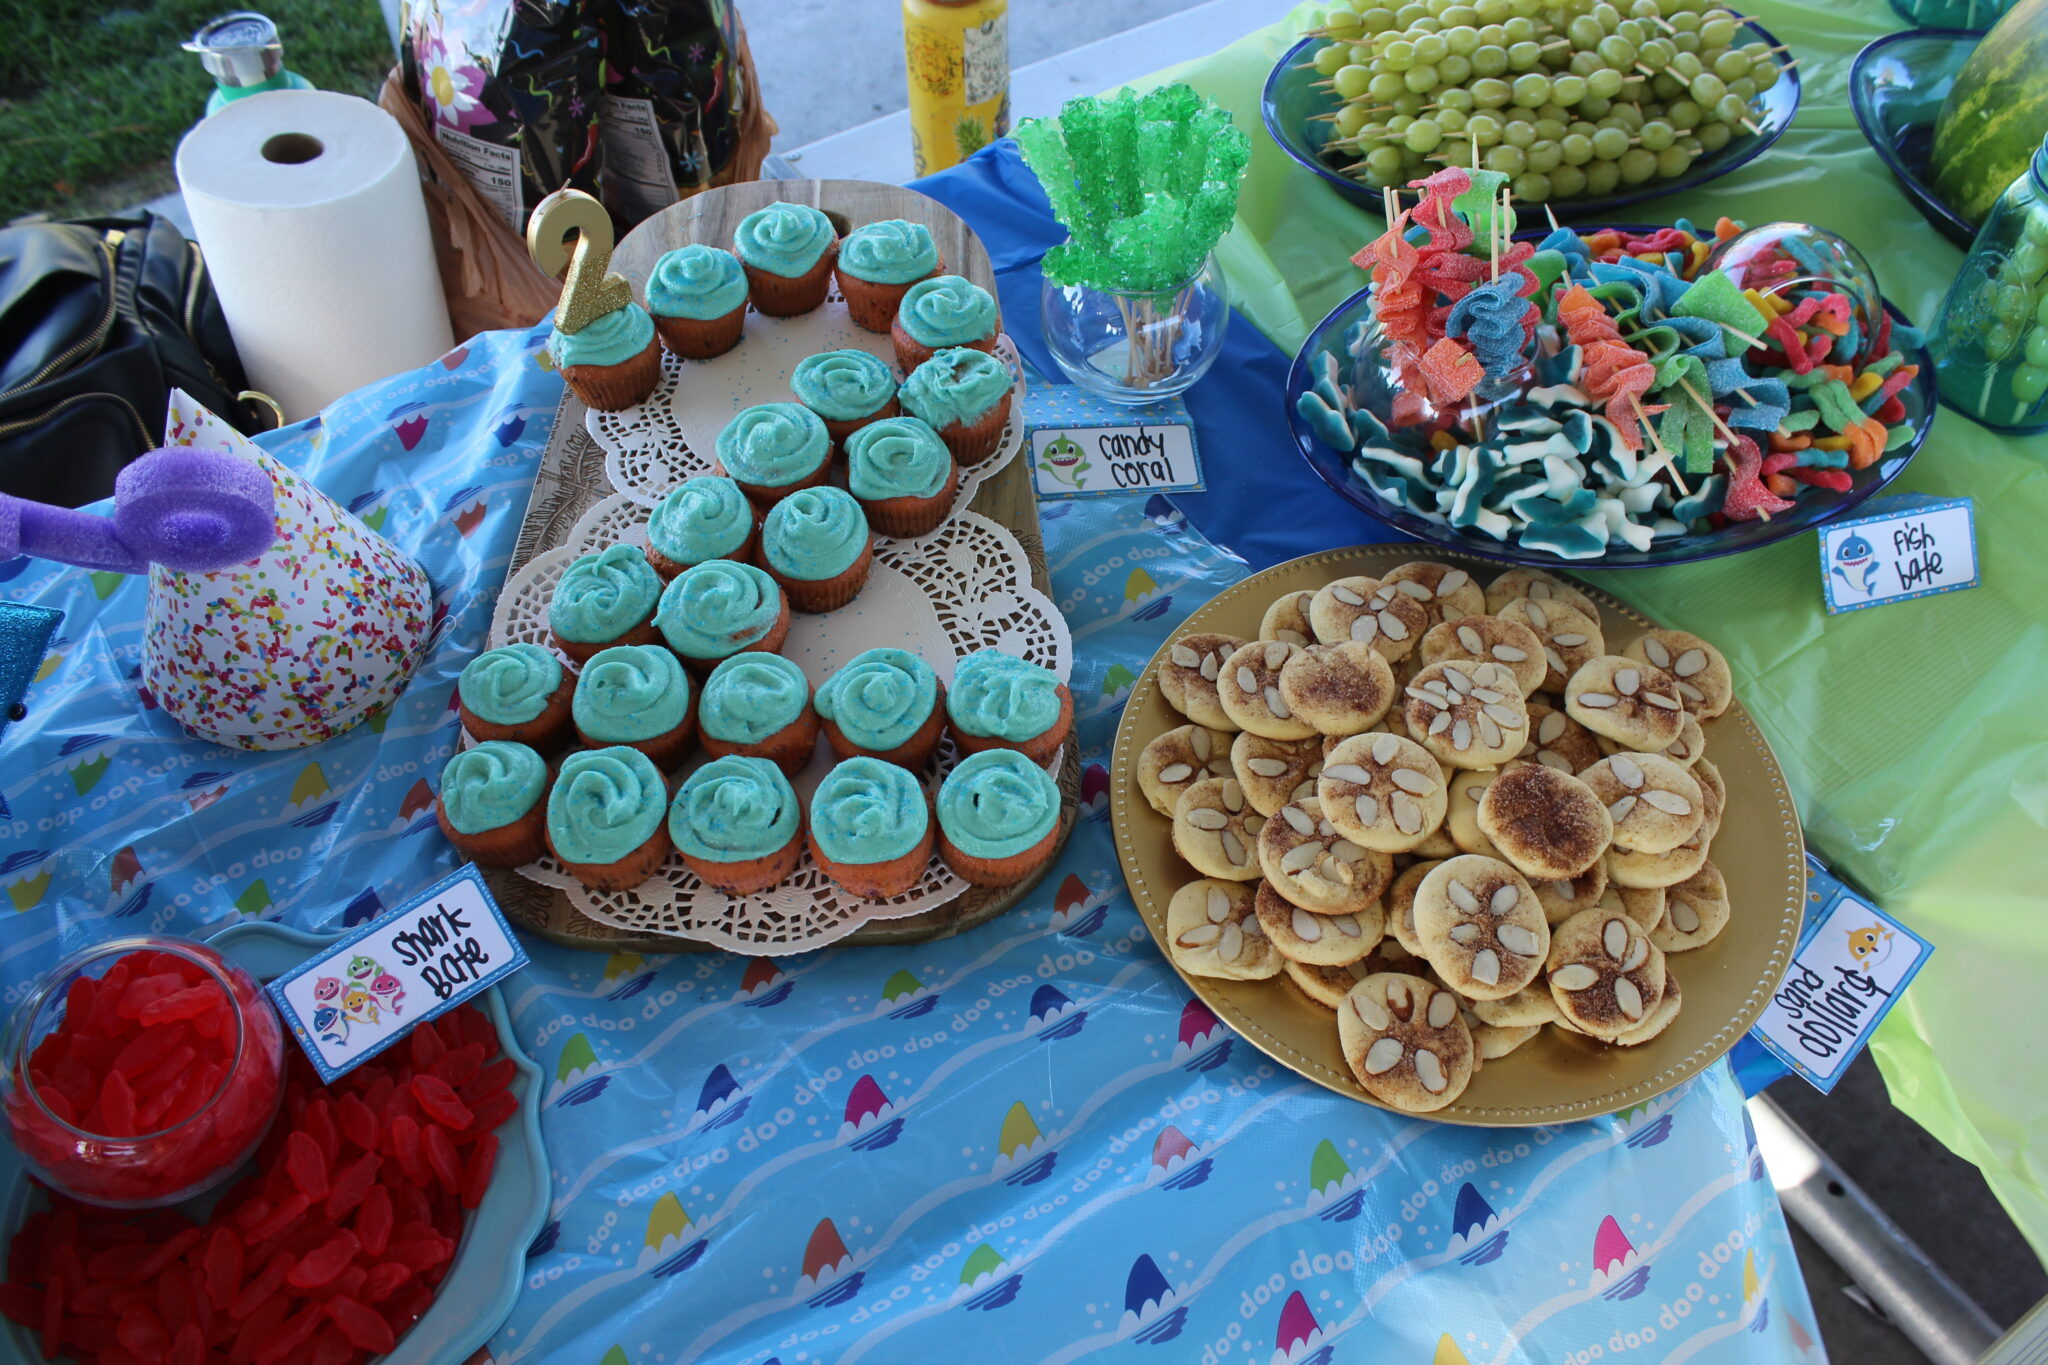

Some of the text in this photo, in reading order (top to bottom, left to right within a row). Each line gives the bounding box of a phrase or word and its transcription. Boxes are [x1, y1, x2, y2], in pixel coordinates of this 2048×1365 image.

[441, 132, 511, 160] Nutrition Facts
[491, 177, 511, 187] 150
[527, 188, 632, 336] 2
[1099, 427, 1165, 460] candy
[1111, 457, 1175, 488] coral
[1893, 522, 1935, 556] fish
[1060, 546, 1171, 613] oo doo doo
[1894, 551, 1943, 590] bate
[423, 743, 451, 764] do
[193, 861, 246, 896] doo
[252, 846, 302, 868] doo
[392, 903, 471, 966] Shark
[536, 1014, 576, 1048] doo
[582, 1013, 636, 1032] doo
[642, 980, 695, 1020] doo
[1774, 958, 1824, 1019] sand
[530, 925, 1146, 1290] doo doo doo doo doo doo doo doo doo doo doo doo
[779, 1324, 841, 1349] doo
[849, 1285, 911, 1324] doo
[911, 1242, 961, 1282] doo
[966, 1215, 1016, 1244] doo
[1023, 1194, 1069, 1221] doo
[1072, 1158, 1113, 1193] doo
[1109, 1117, 1156, 1154] doo
[1160, 1088, 1221, 1119] doo
[1227, 1064, 1275, 1098] doo
[1239, 1273, 1286, 1319] doo
[1290, 1249, 1355, 1281] doo
[1359, 1223, 1402, 1264] doo
[1401, 1180, 1440, 1223] doo
[1441, 1159, 1478, 1185] doo
[1481, 1142, 1530, 1169] doo
[1608, 1327, 1657, 1353] doo
[1659, 1282, 1705, 1331] doo
[1698, 1229, 1745, 1279] doo
